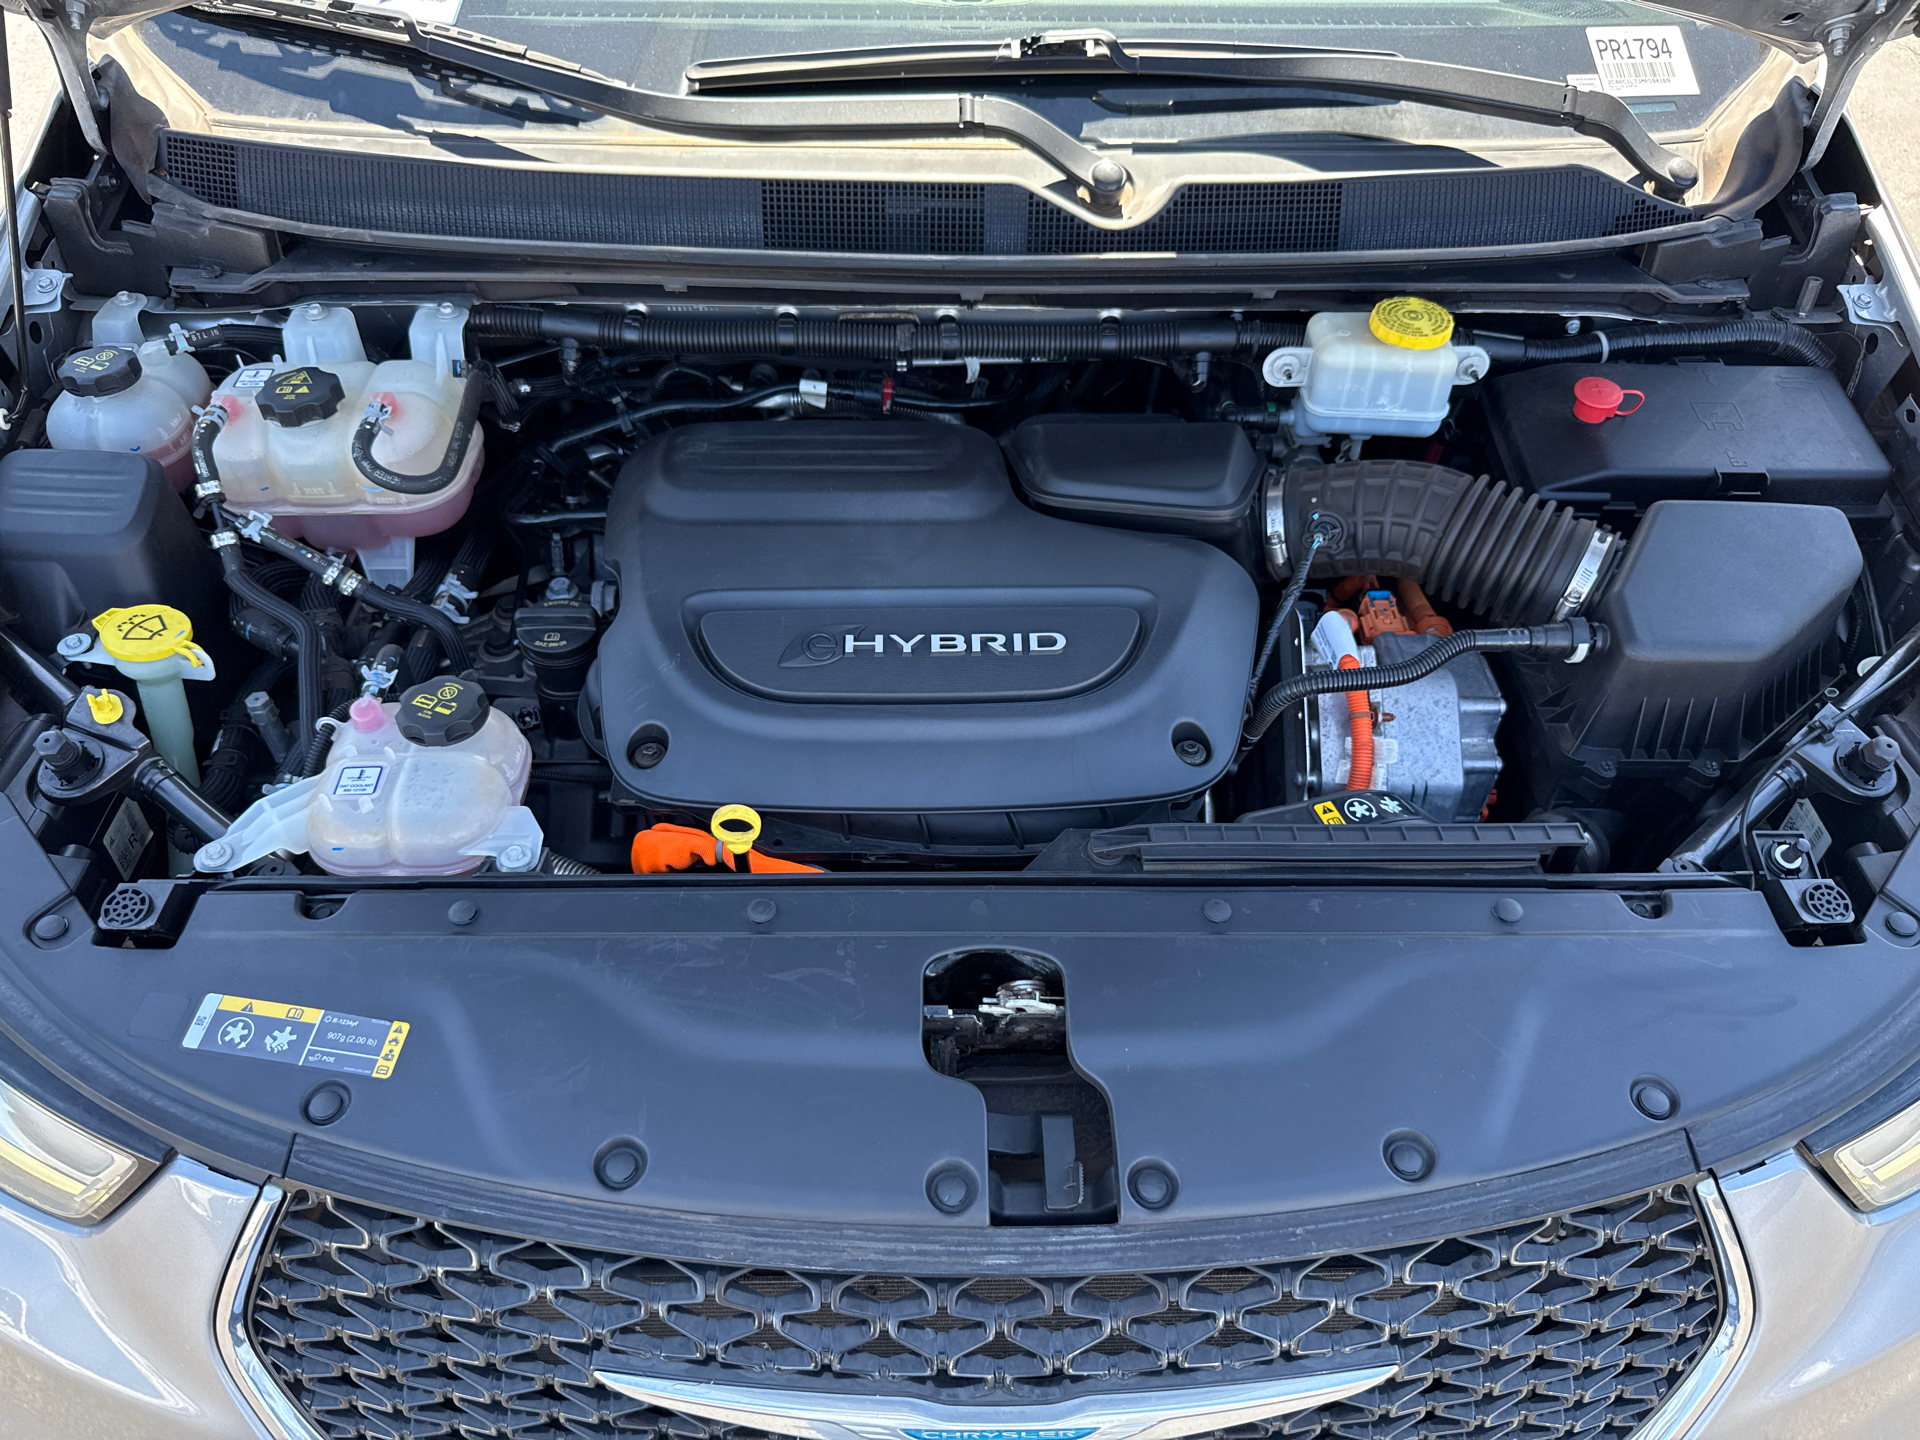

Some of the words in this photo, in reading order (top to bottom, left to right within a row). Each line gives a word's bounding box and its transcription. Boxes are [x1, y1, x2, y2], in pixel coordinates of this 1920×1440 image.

[1595, 38, 1672, 60] PR1794
[191, 332, 208, 341] BTL
[211, 329, 221, 337] IN
[374, 468, 401, 486] HEATER
[548, 640, 567, 648] 0W-20
[844, 632, 1067, 654] HYBRID
[332, 1016, 359, 1028] R-1234yf
[326, 1031, 346, 1043] 907g
[346, 1034, 367, 1046] (2.00
[366, 1038, 378, 1048] lb)
[920, 1429, 1077, 1440] CHRYSLER
